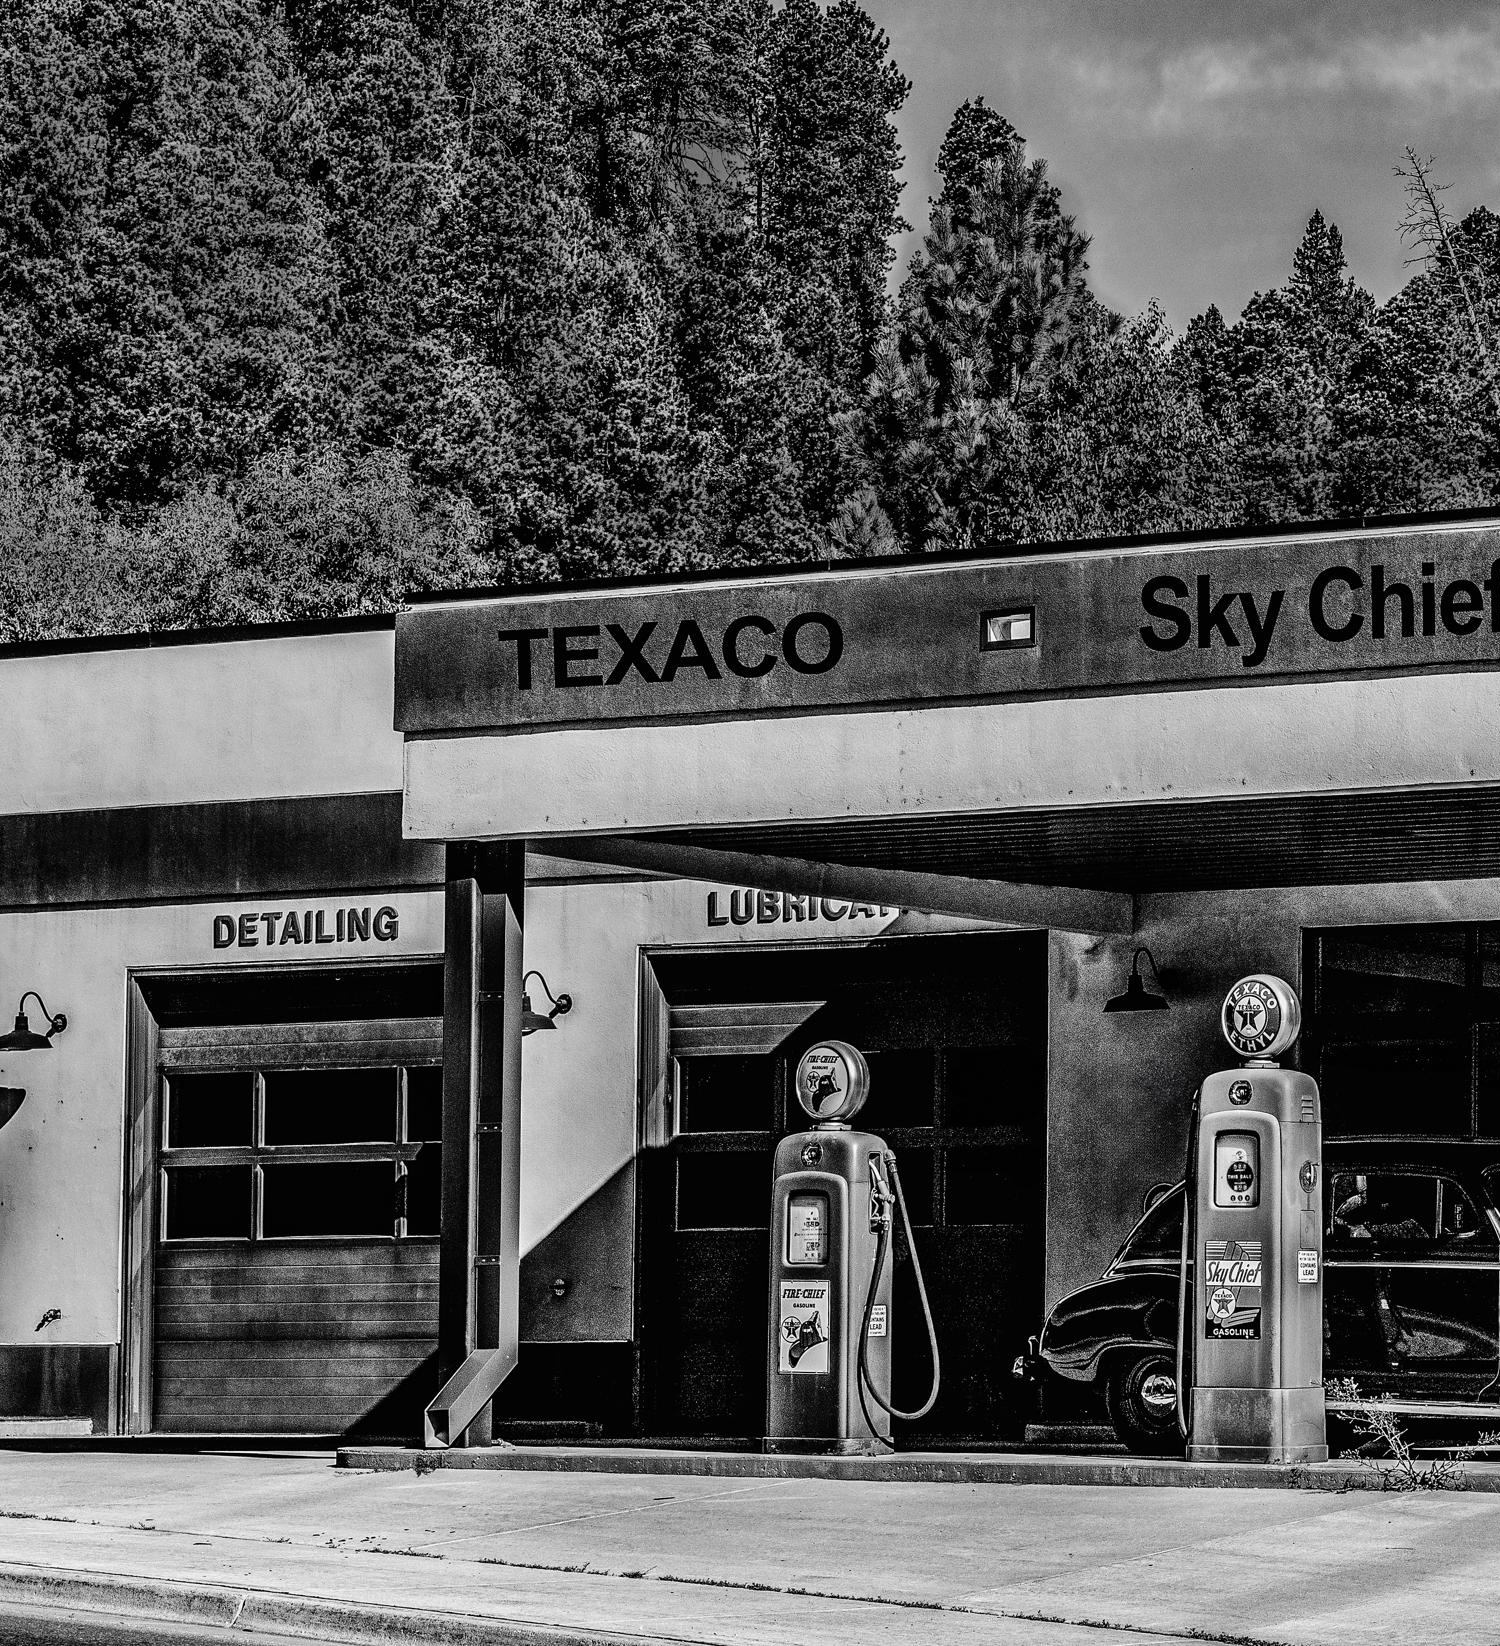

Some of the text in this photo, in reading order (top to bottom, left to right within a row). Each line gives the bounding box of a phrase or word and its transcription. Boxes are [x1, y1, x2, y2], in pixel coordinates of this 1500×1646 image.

[1139, 574, 1285, 667] Sky
[498, 611, 844, 691] TEXACO
[213, 906, 399, 949] DETAILING
[1227, 983, 1278, 1009] TEXACO
[1229, 1030, 1275, 1051] ETHYL
[1207, 1261, 1262, 1287] Sky Chief
[782, 1288, 827, 1299] FIRE-CHIEF
[1212, 1328, 1255, 1336] GASOLINE
